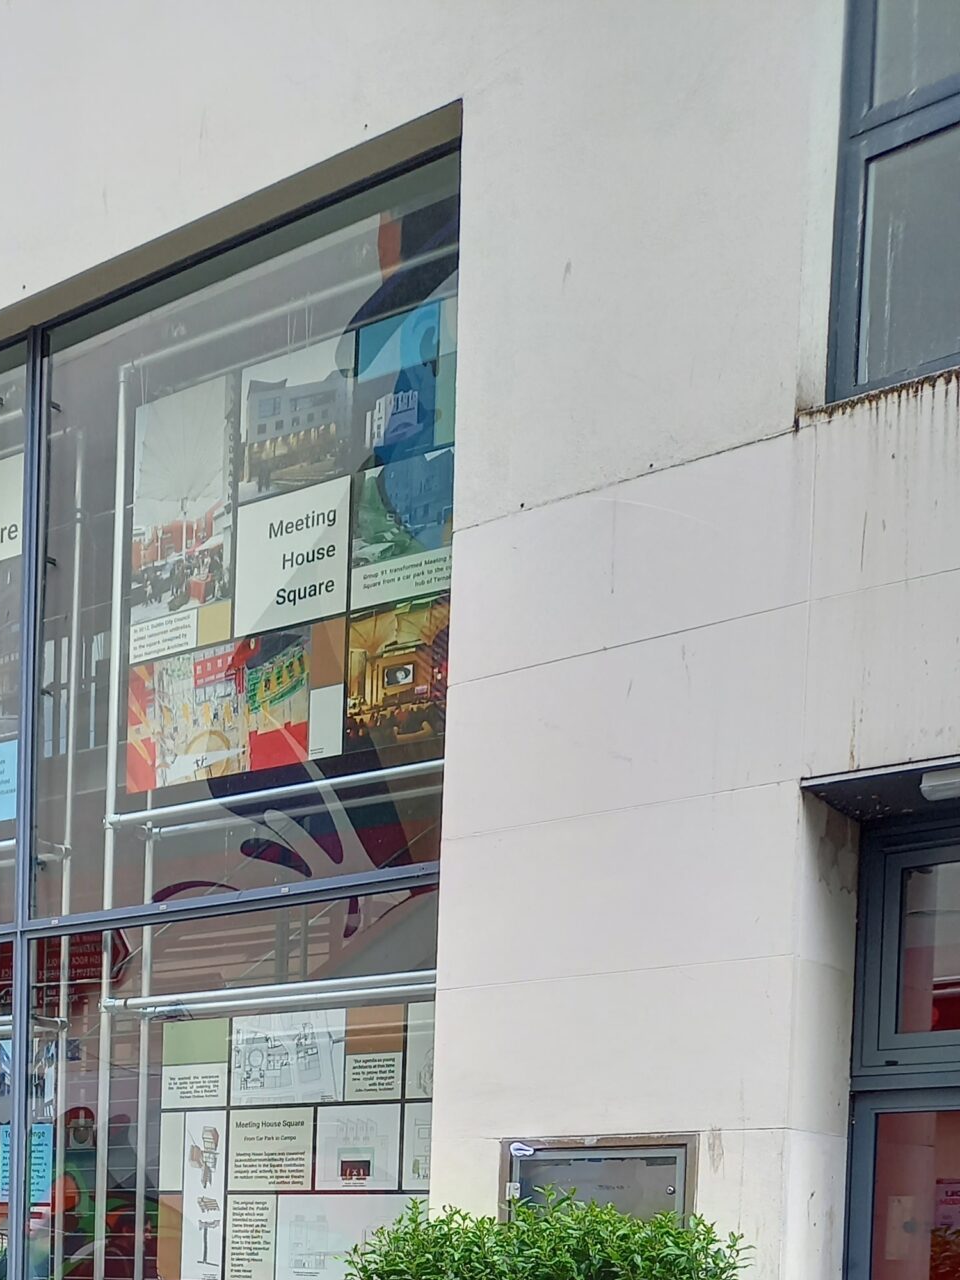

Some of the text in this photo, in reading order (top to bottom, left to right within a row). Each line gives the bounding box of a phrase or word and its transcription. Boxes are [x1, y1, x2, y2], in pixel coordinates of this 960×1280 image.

[269, 509, 337, 539] Meeting
[282, 544, 336, 570] House
[363, 572, 378, 580] Group
[389, 562, 422, 574] transformed
[424, 556, 447, 565] Meeting
[276, 579, 335, 606] Square
[363, 581, 381, 589] Square
[383, 577, 395, 585] from
[413, 571, 424, 579] park
[235, 1120, 260, 1129] Meeting
[282, 1120, 305, 1128] Square
